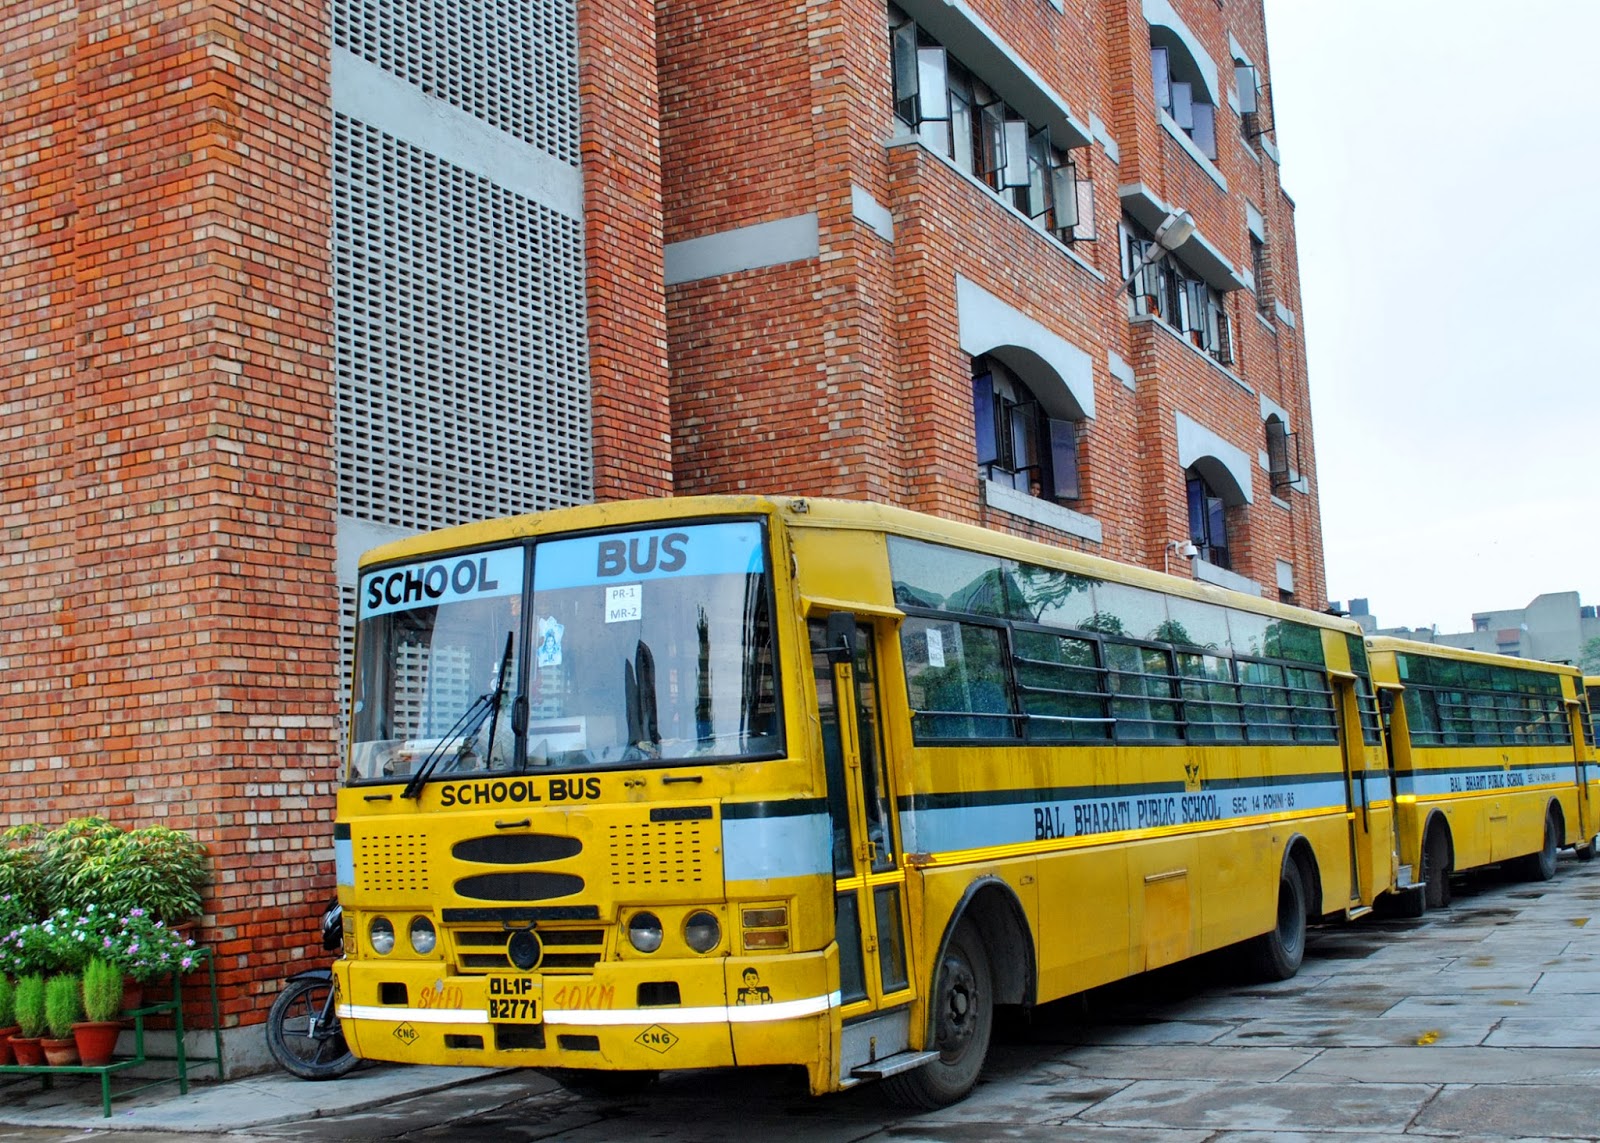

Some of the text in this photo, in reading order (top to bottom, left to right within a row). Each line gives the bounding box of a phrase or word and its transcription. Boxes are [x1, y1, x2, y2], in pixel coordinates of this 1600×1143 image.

[597, 533, 689, 577] BUS
[368, 557, 498, 609] SCHOOL
[612, 588, 635, 599] PR-1
[610, 607, 637, 619] MR-2
[440, 777, 601, 806] SCHOOL BUS
[1450, 777, 1462, 792] BAL
[1232, 796, 1248, 814] SEC
[1252, 795, 1260, 811] 14
[1034, 794, 1221, 840] BAL BHARATI PUBLIC SCHOOL
[553, 985, 614, 1010] 40KM
[490, 999, 536, 1019] B2771
[397, 1028, 415, 1040] CNG
[642, 1033, 671, 1046] CNG
